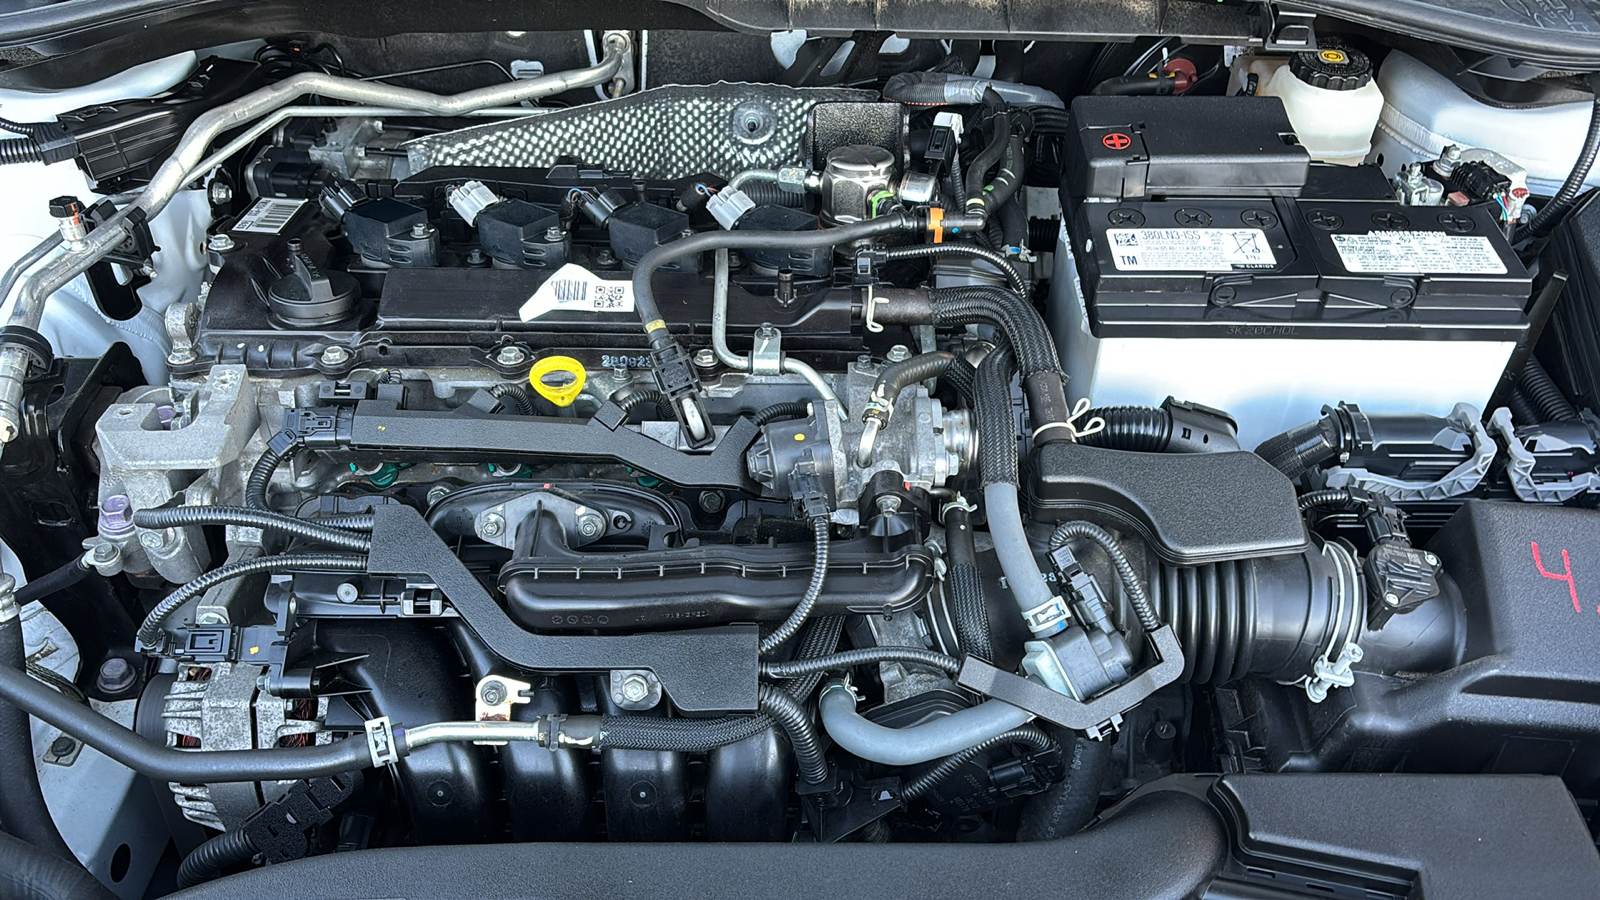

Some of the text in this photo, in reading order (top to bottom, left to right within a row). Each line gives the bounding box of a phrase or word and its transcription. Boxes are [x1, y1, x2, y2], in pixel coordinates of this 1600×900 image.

[1140, 230, 1201, 241] 380LN3-ISS
[1120, 255, 1139, 266] TM
[1531, 541, 1581, 613] 4
